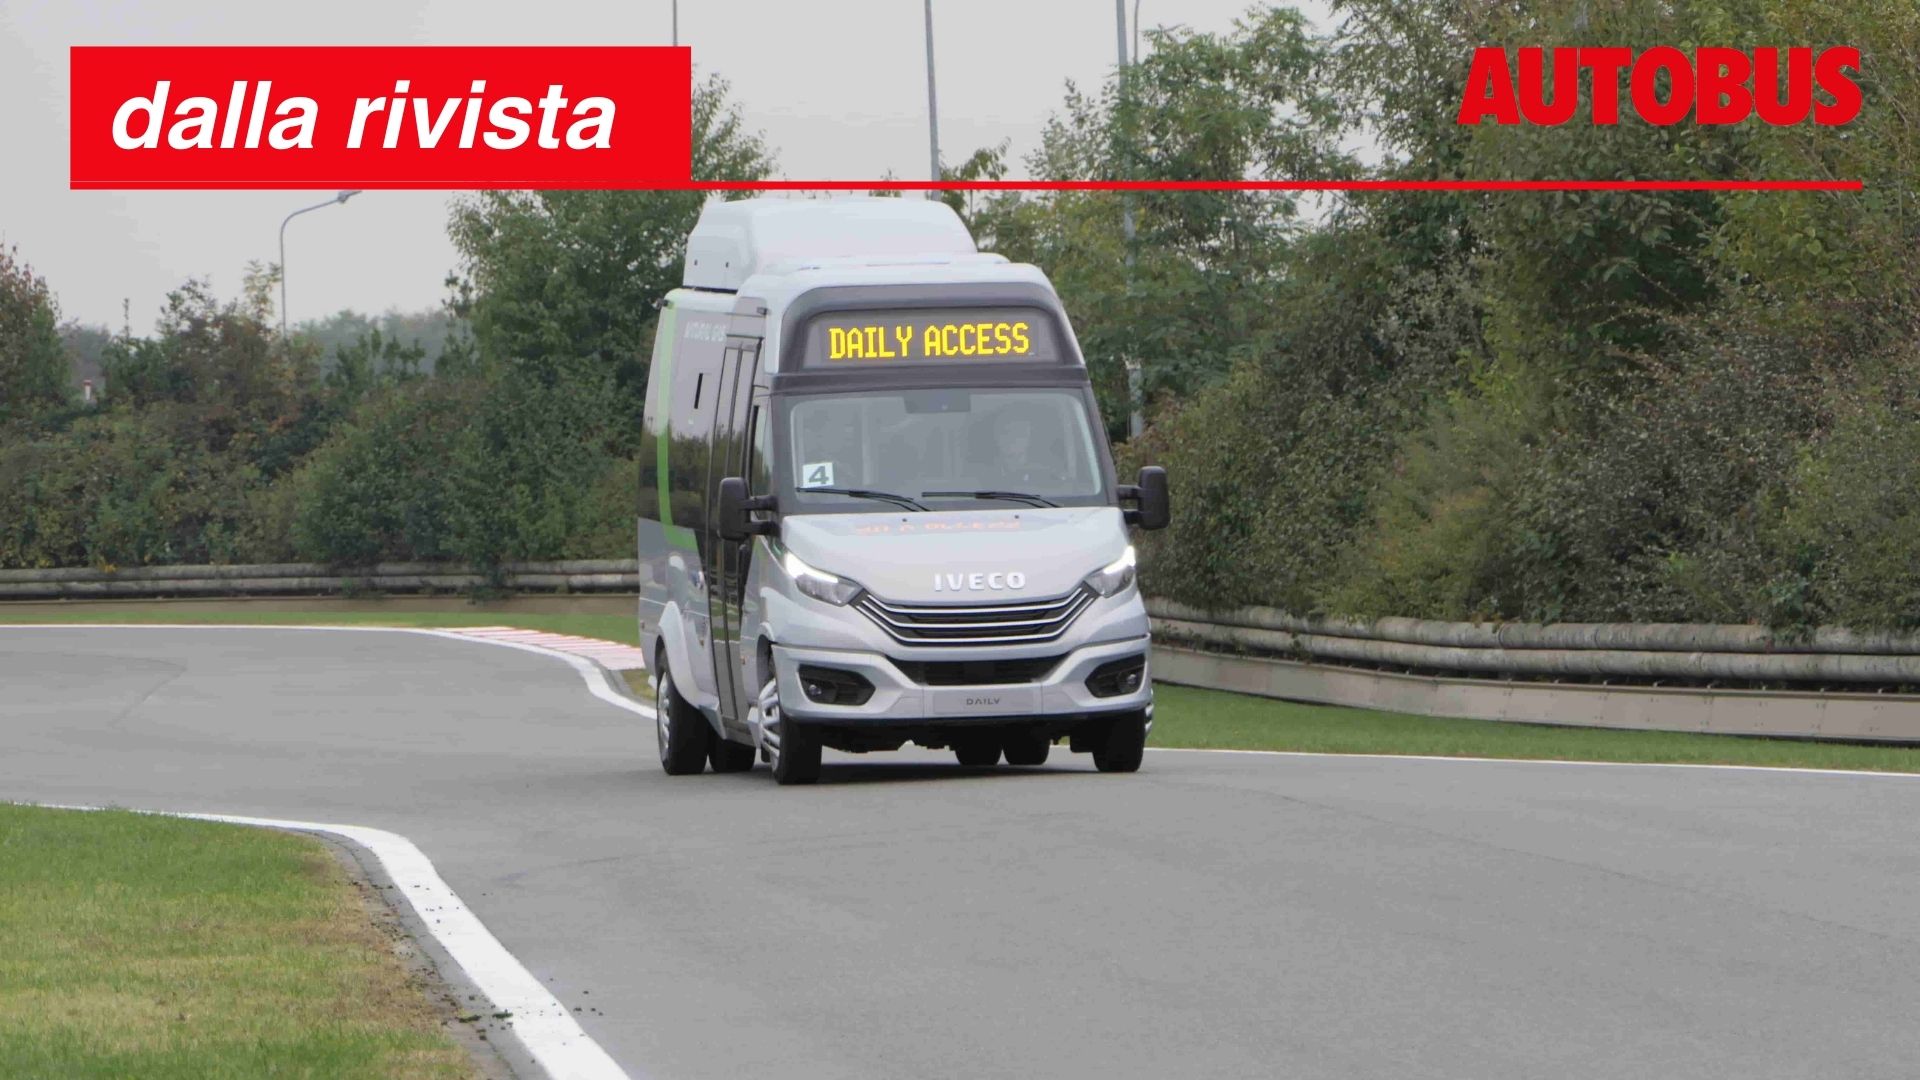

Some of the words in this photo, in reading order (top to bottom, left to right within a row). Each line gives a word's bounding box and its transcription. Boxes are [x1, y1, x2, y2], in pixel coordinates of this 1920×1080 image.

[829, 326, 913, 359] DAILY
[924, 322, 1030, 356] ACCESS
[808, 465, 830, 485] 4
[934, 571, 1026, 592] IVECO
[966, 697, 1000, 706] DAILY
